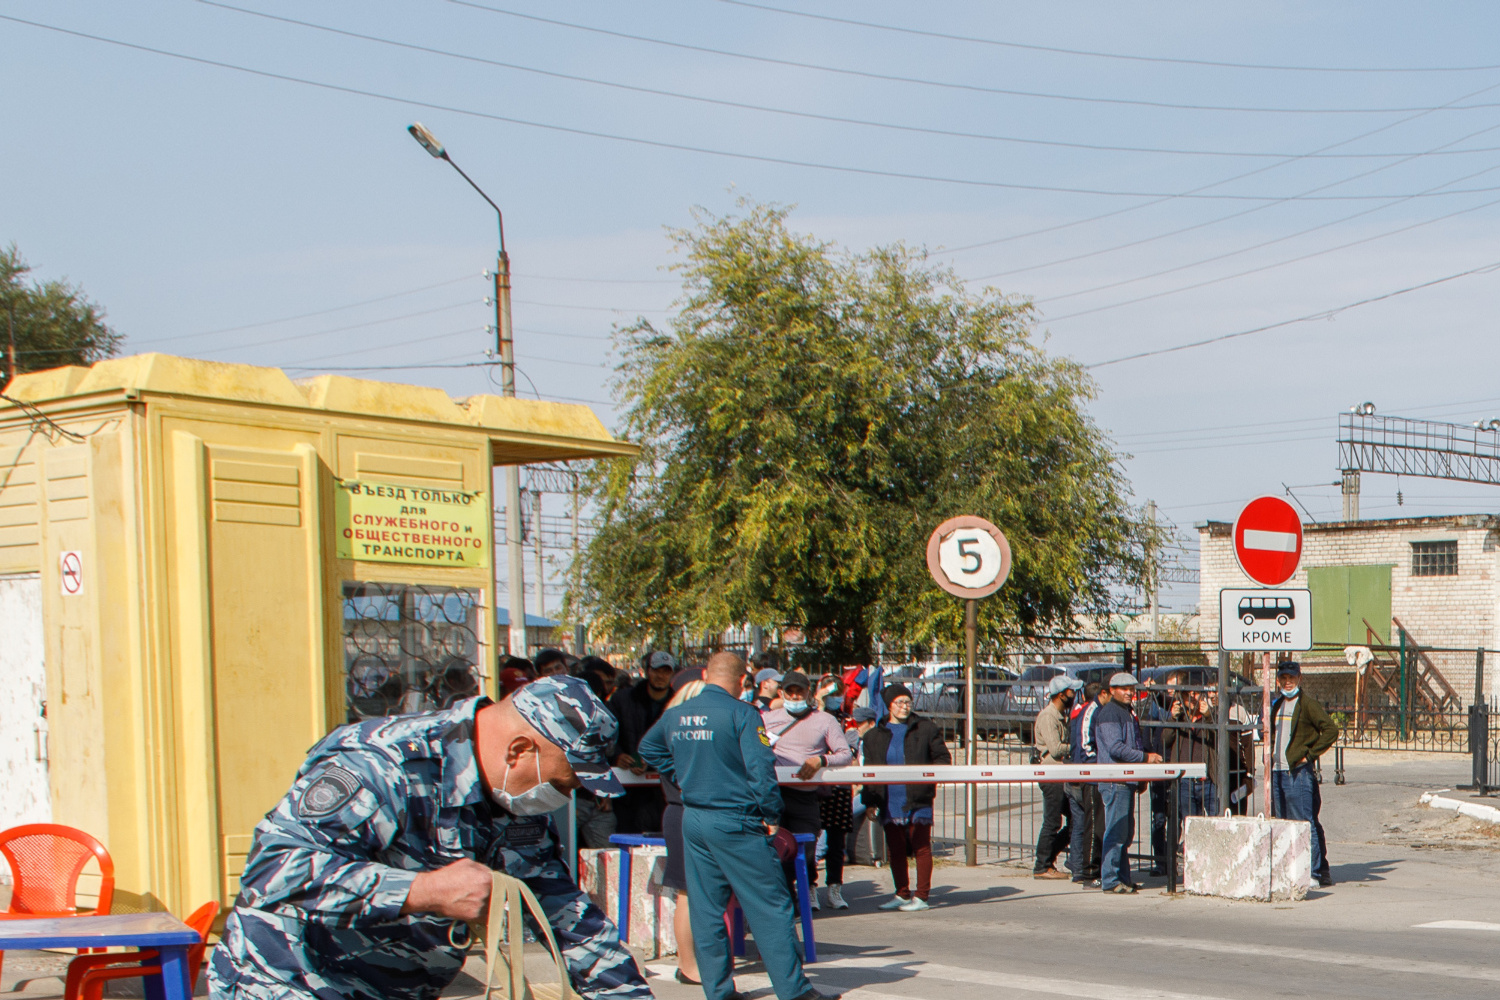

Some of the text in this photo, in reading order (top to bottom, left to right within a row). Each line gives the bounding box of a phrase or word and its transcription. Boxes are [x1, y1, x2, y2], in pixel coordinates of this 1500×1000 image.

[351, 484, 471, 505] ВЪЕЗД ТОЛЬКО
[400, 505, 427, 515] для
[353, 514, 473, 533] СЛУЖЕБНОГО и
[343, 528, 482, 549] ОБЩЕСТВЕННОГО
[362, 544, 465, 561] ТРАНСПОРТА
[957, 538, 983, 575] 5
[1242, 631, 1291, 643] КРОМЕ
[680, 716, 708, 727] МЧС
